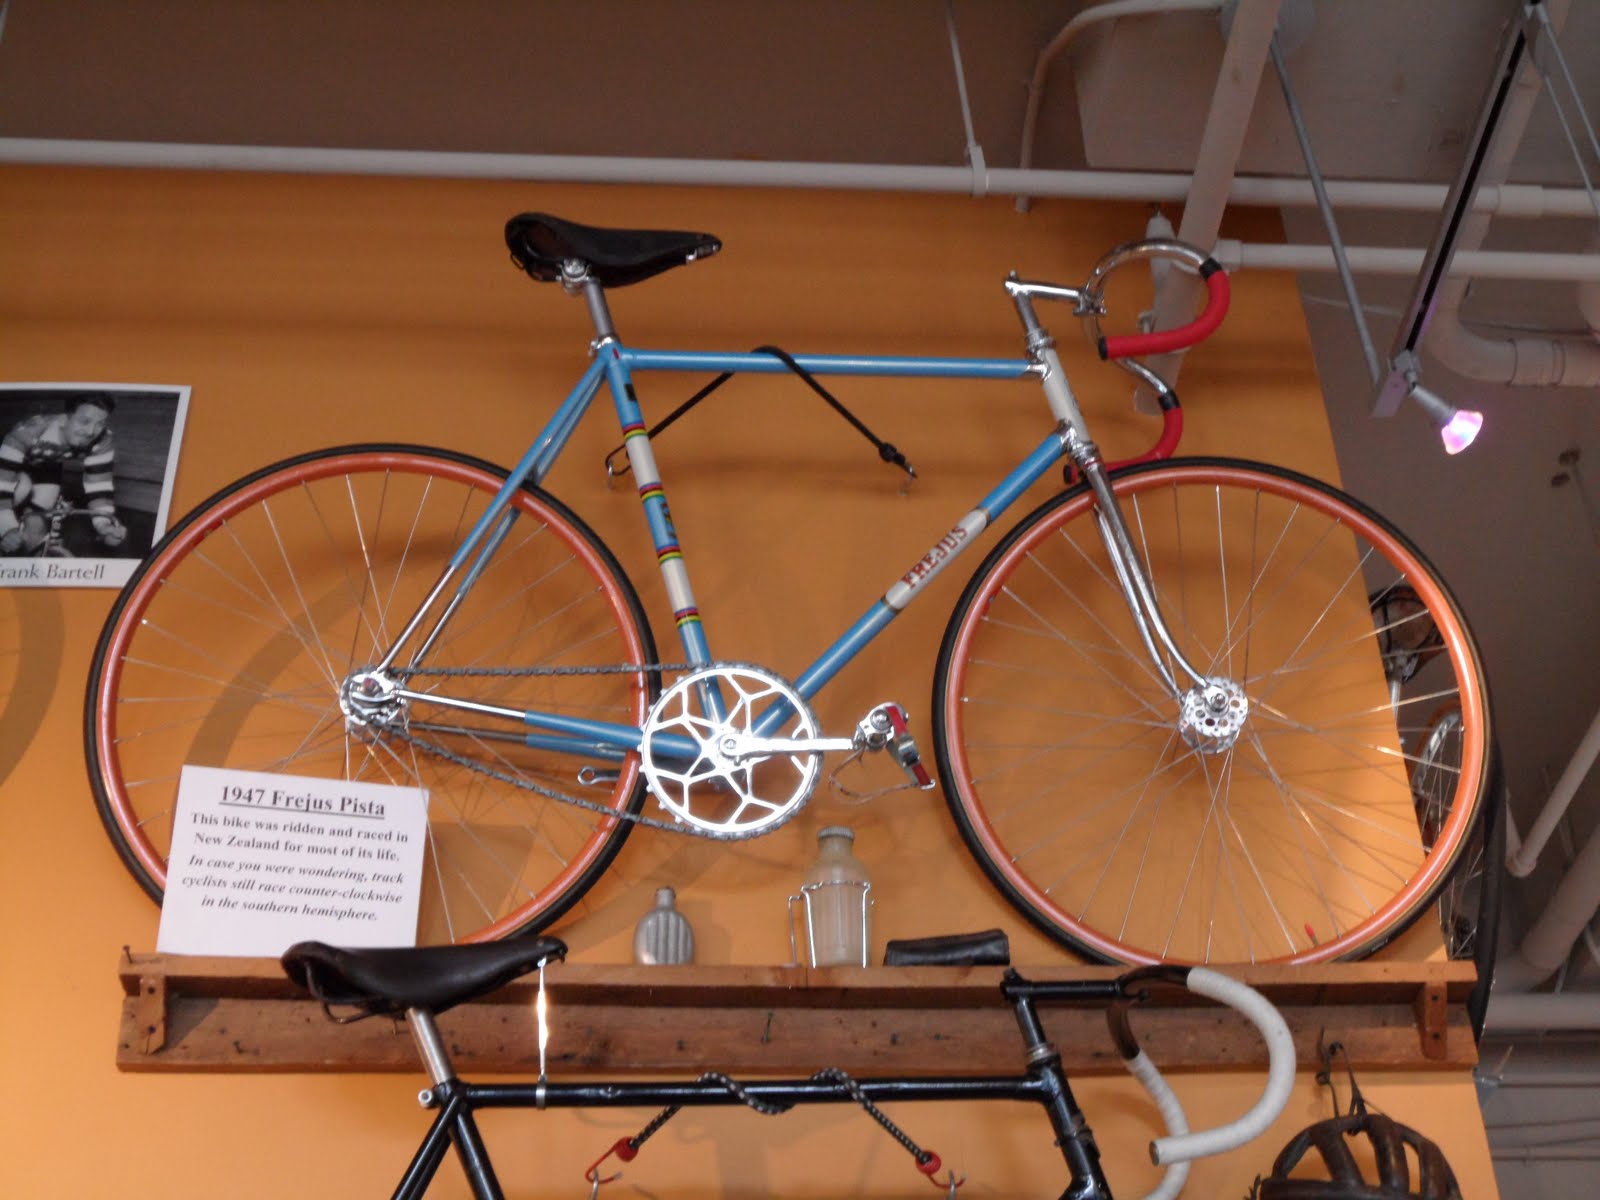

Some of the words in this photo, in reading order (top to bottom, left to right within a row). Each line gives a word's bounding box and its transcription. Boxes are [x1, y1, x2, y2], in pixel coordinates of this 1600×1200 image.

[0, 563, 40, 579] rank
[47, 563, 105, 579] Bartell
[900, 526, 967, 589] FREJUS
[219, 785, 267, 805] 1947
[271, 790, 334, 813] Frejus
[340, 797, 385, 816] Pista
[191, 812, 219, 826] This
[222, 815, 251, 829] bike
[254, 820, 279, 832] was
[282, 821, 325, 836] ridden
[328, 826, 354, 838] and
[356, 828, 393, 842] raced
[397, 831, 409, 843] in
[195, 832, 222, 845] New
[226, 835, 280, 851] Zealand
[284, 840, 302, 852] for
[307, 843, 339, 857] most
[342, 846, 356, 858] of
[357, 847, 374, 859] its
[376, 848, 400, 861] life.
[188, 854, 204, 867] In
[207, 858, 235, 870] case
[238, 861, 261, 875] you
[265, 863, 296, 874] were
[299, 866, 368, 883] wondering,
[371, 871, 404, 884] track
[181, 875, 229, 891] cyclists
[232, 879, 255, 891] still
[258, 883, 287, 894] race
[288, 884, 403, 904] counter-clockwise
[201, 895, 216, 907] in
[218, 896, 240, 910] the
[242, 900, 298, 914] southern
[302, 903, 378, 921] hemisphere.
